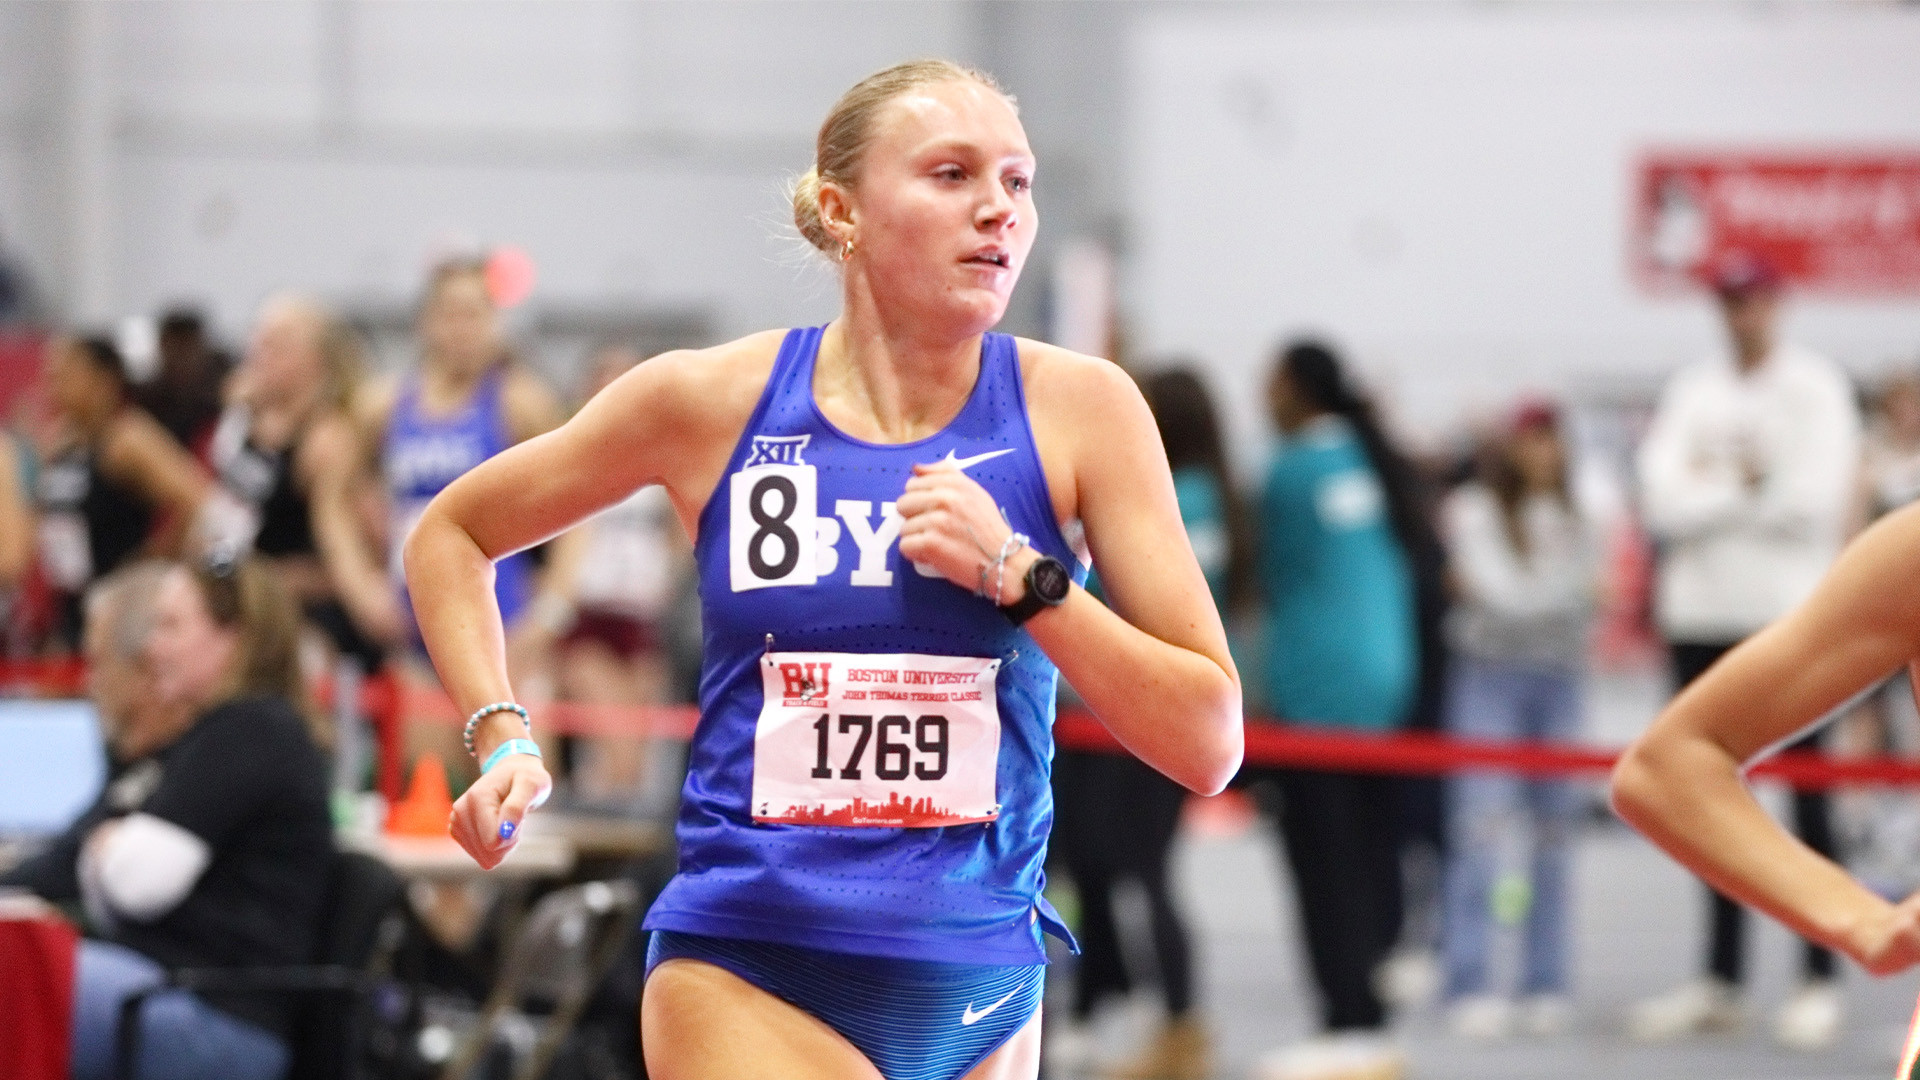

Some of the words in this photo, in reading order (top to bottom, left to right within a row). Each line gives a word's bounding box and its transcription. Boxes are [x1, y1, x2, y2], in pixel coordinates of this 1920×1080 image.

[748, 475, 799, 580] 8
[816, 499, 949, 586] BY
[779, 662, 832, 699] BU
[847, 669, 899, 683] BOSTON
[903, 670, 980, 685] UNIVERSITY
[842, 690, 867, 701] JOHN
[869, 691, 908, 701] THOMAS
[910, 691, 950, 702] TERRIER
[951, 691, 981, 701] CLASSIC
[811, 714, 949, 780] 1769
[852, 816, 904, 825] GoTerriers.com
